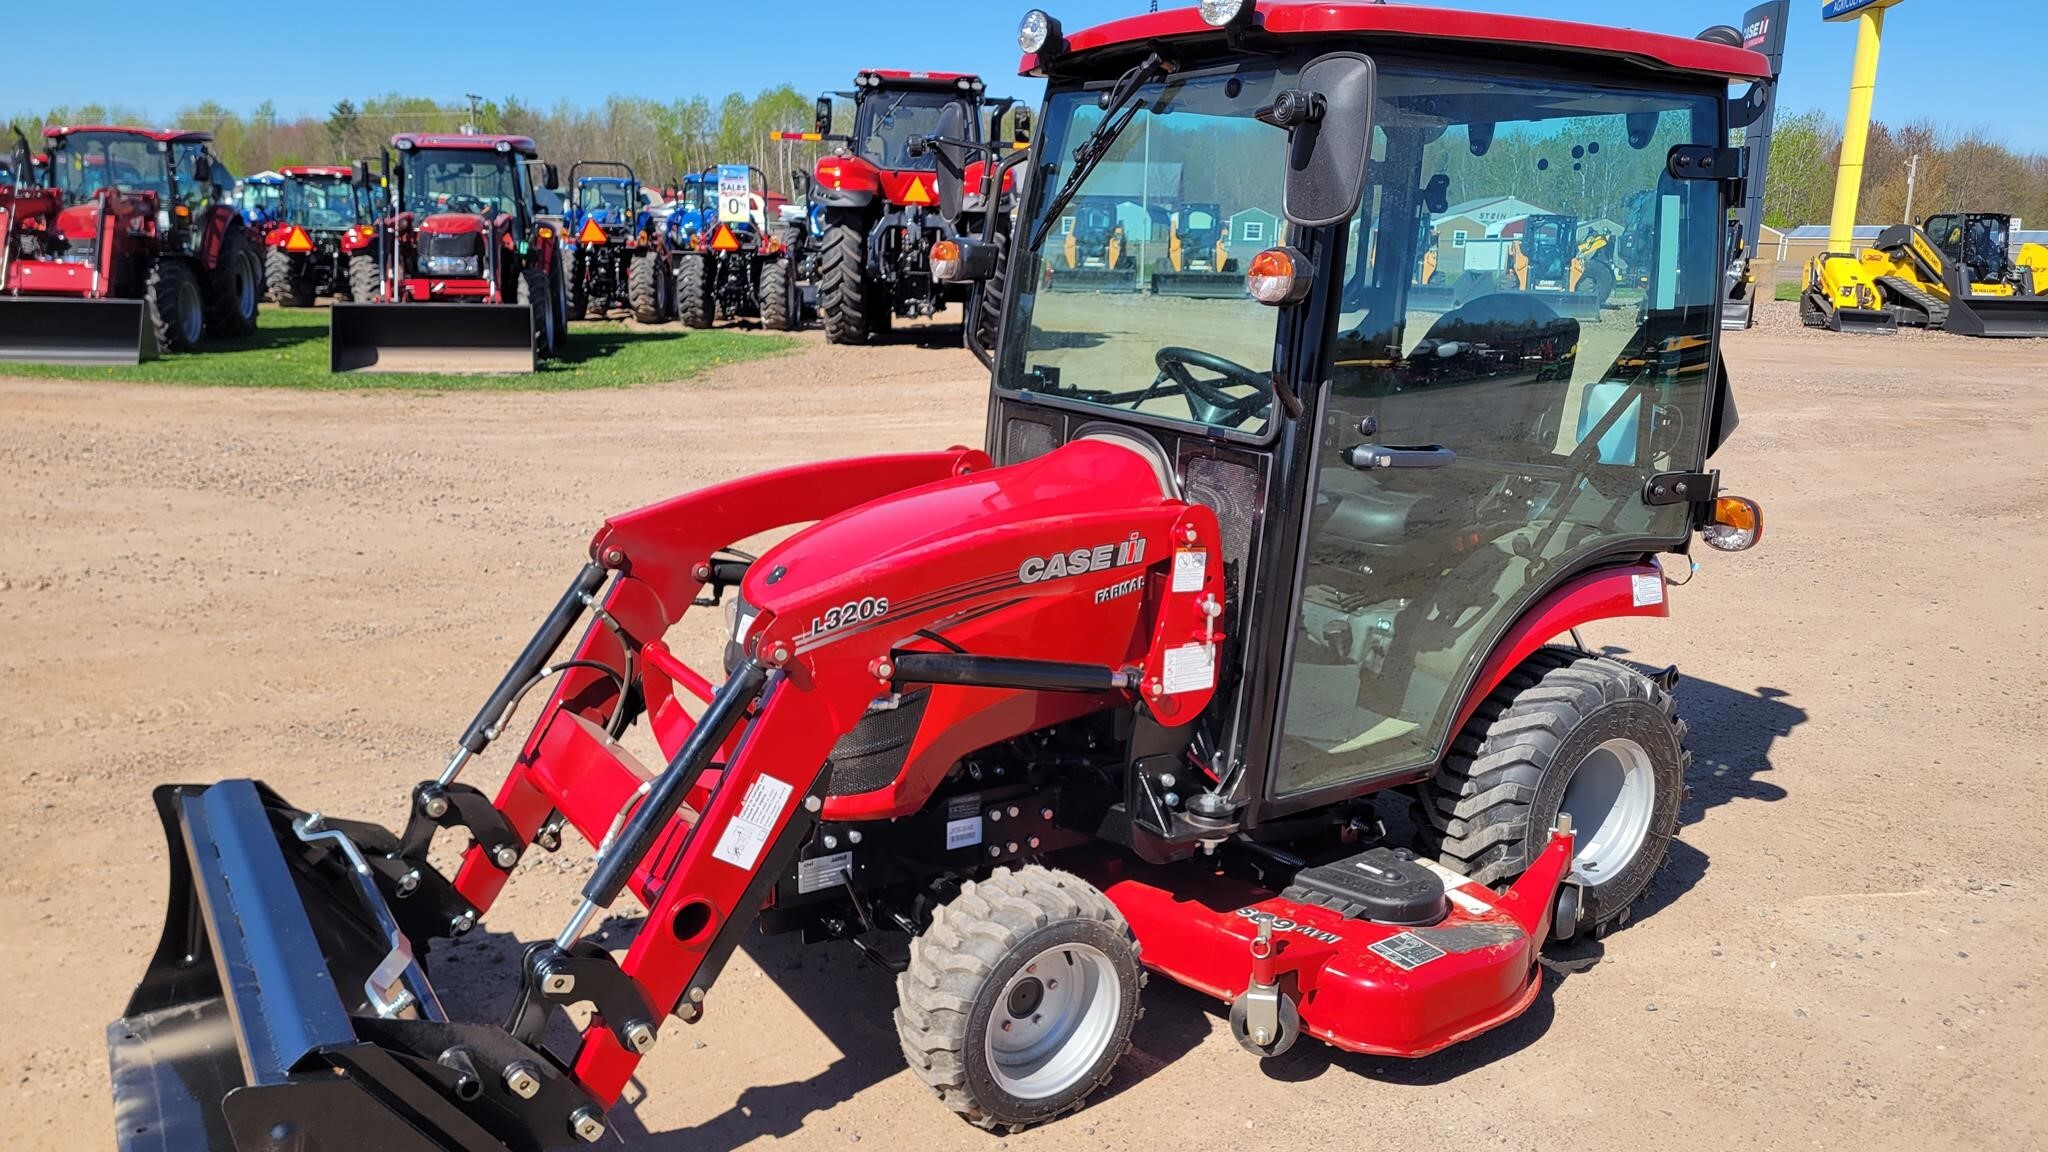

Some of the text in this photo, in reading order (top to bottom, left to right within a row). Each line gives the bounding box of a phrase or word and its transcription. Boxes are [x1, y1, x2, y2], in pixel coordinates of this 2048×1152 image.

[721, 183, 747, 191] SALES
[1479, 211, 1507, 220] STEIN
[1019, 543, 1115, 583] CASE
